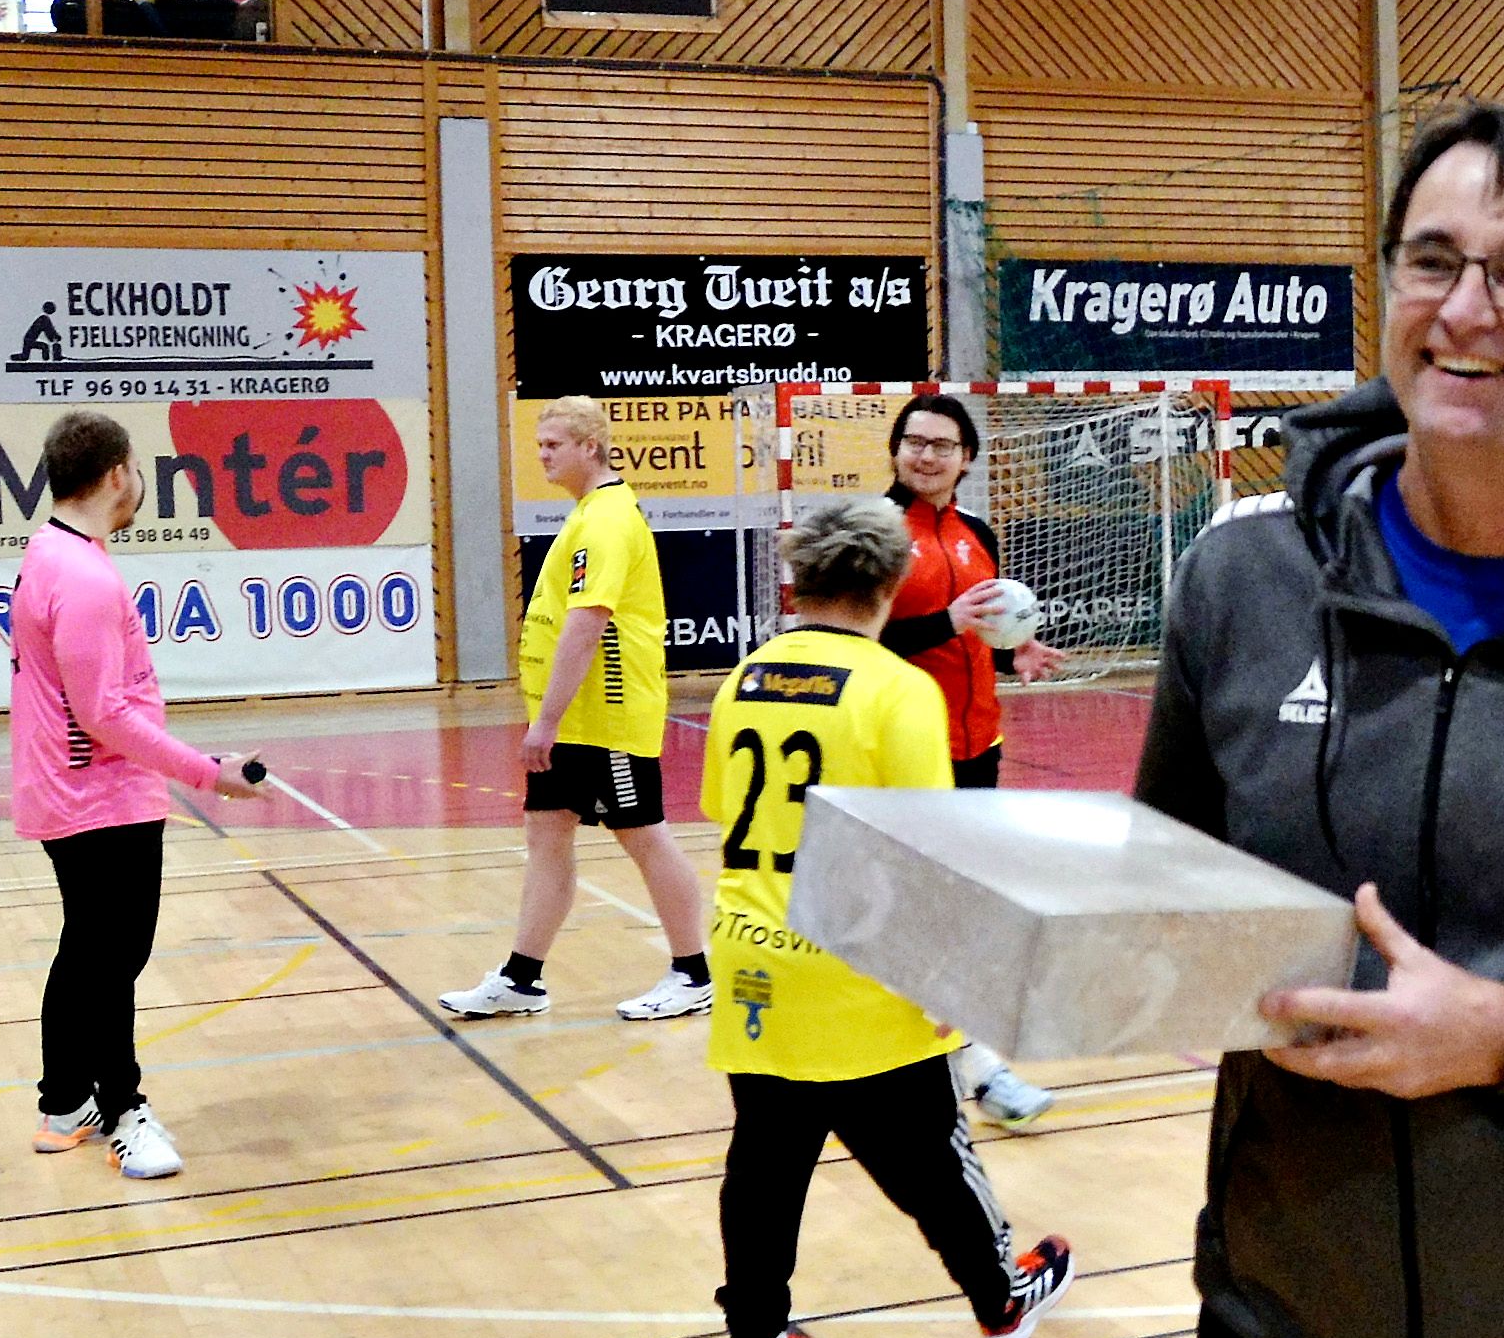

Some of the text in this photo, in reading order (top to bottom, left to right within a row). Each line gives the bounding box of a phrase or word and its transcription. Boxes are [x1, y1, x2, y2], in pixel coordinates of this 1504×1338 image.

[67, 281, 231, 317] ECKHOLDT
[528, 264, 911, 318] Georg Tveit a/s
[1029, 268, 1328, 335] Kragerø Auto
[68, 323, 251, 349] FJELLSPRENGNING
[655, 322, 796, 348] KRAGERØ
[36, 379, 74, 397] TLF
[85, 379, 116, 397] 96
[121, 379, 147, 397] 90
[154, 379, 180, 397] 14
[185, 378, 210, 396] 31
[230, 375, 330, 395] KRAGERØ
[600, 363, 852, 386] www.kvartsbrudd.no
[602, 401, 669, 422] EIER
[678, 396, 710, 421] PÅ
[110, 531, 131, 543] 35
[136, 529, 157, 543] 98
[162, 528, 184, 542] 84
[189, 527, 210, 541] 49
[242, 571, 419, 639] 1000
[723, 727, 823, 874] 23
